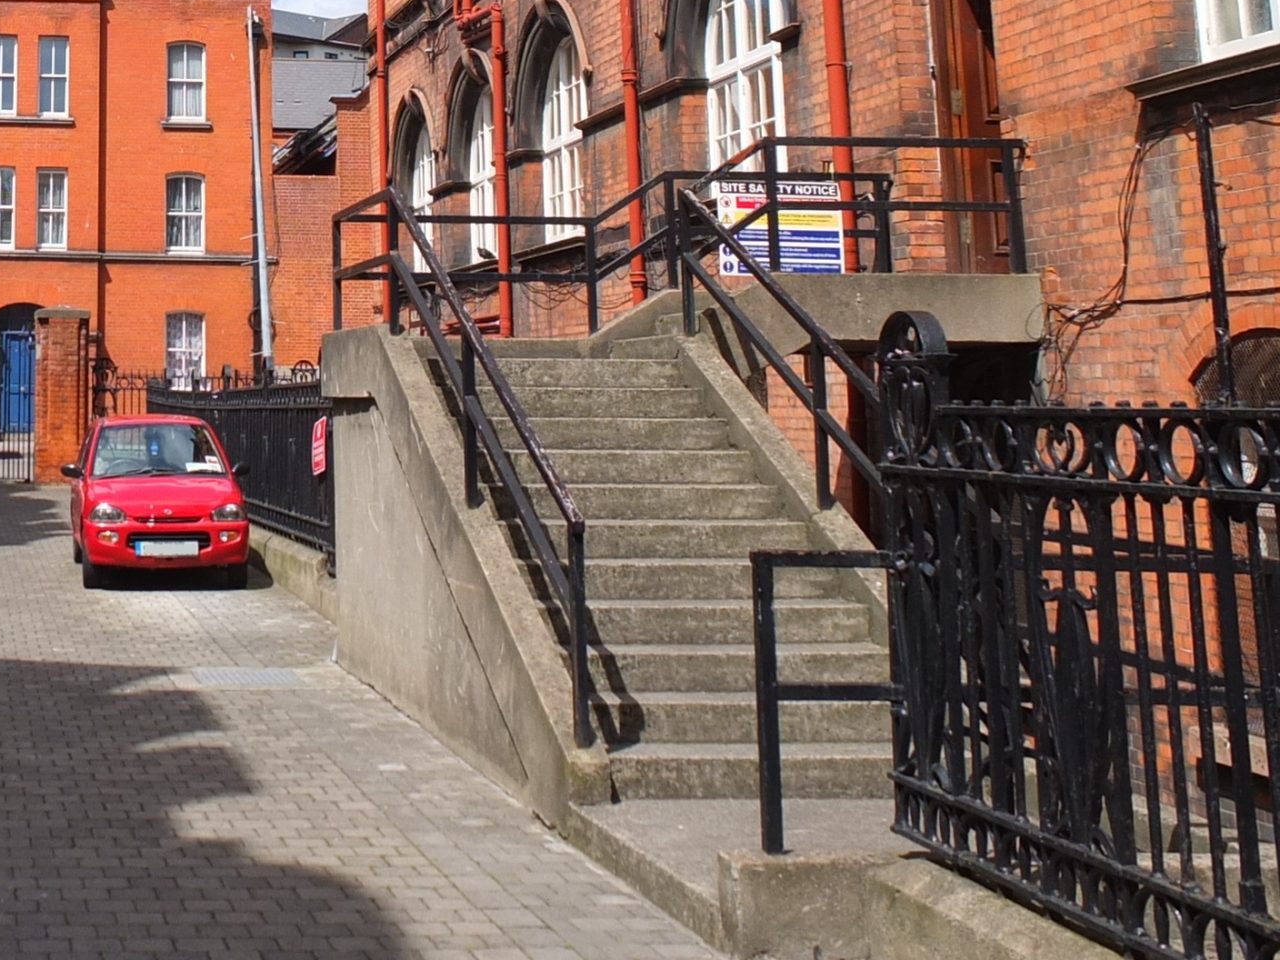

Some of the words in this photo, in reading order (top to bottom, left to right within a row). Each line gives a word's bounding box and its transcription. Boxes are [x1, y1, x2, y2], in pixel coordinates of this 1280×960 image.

[721, 182, 747, 193] SITE
[748, 183, 793, 194] SATY
[795, 185, 836, 196] NOTICE
